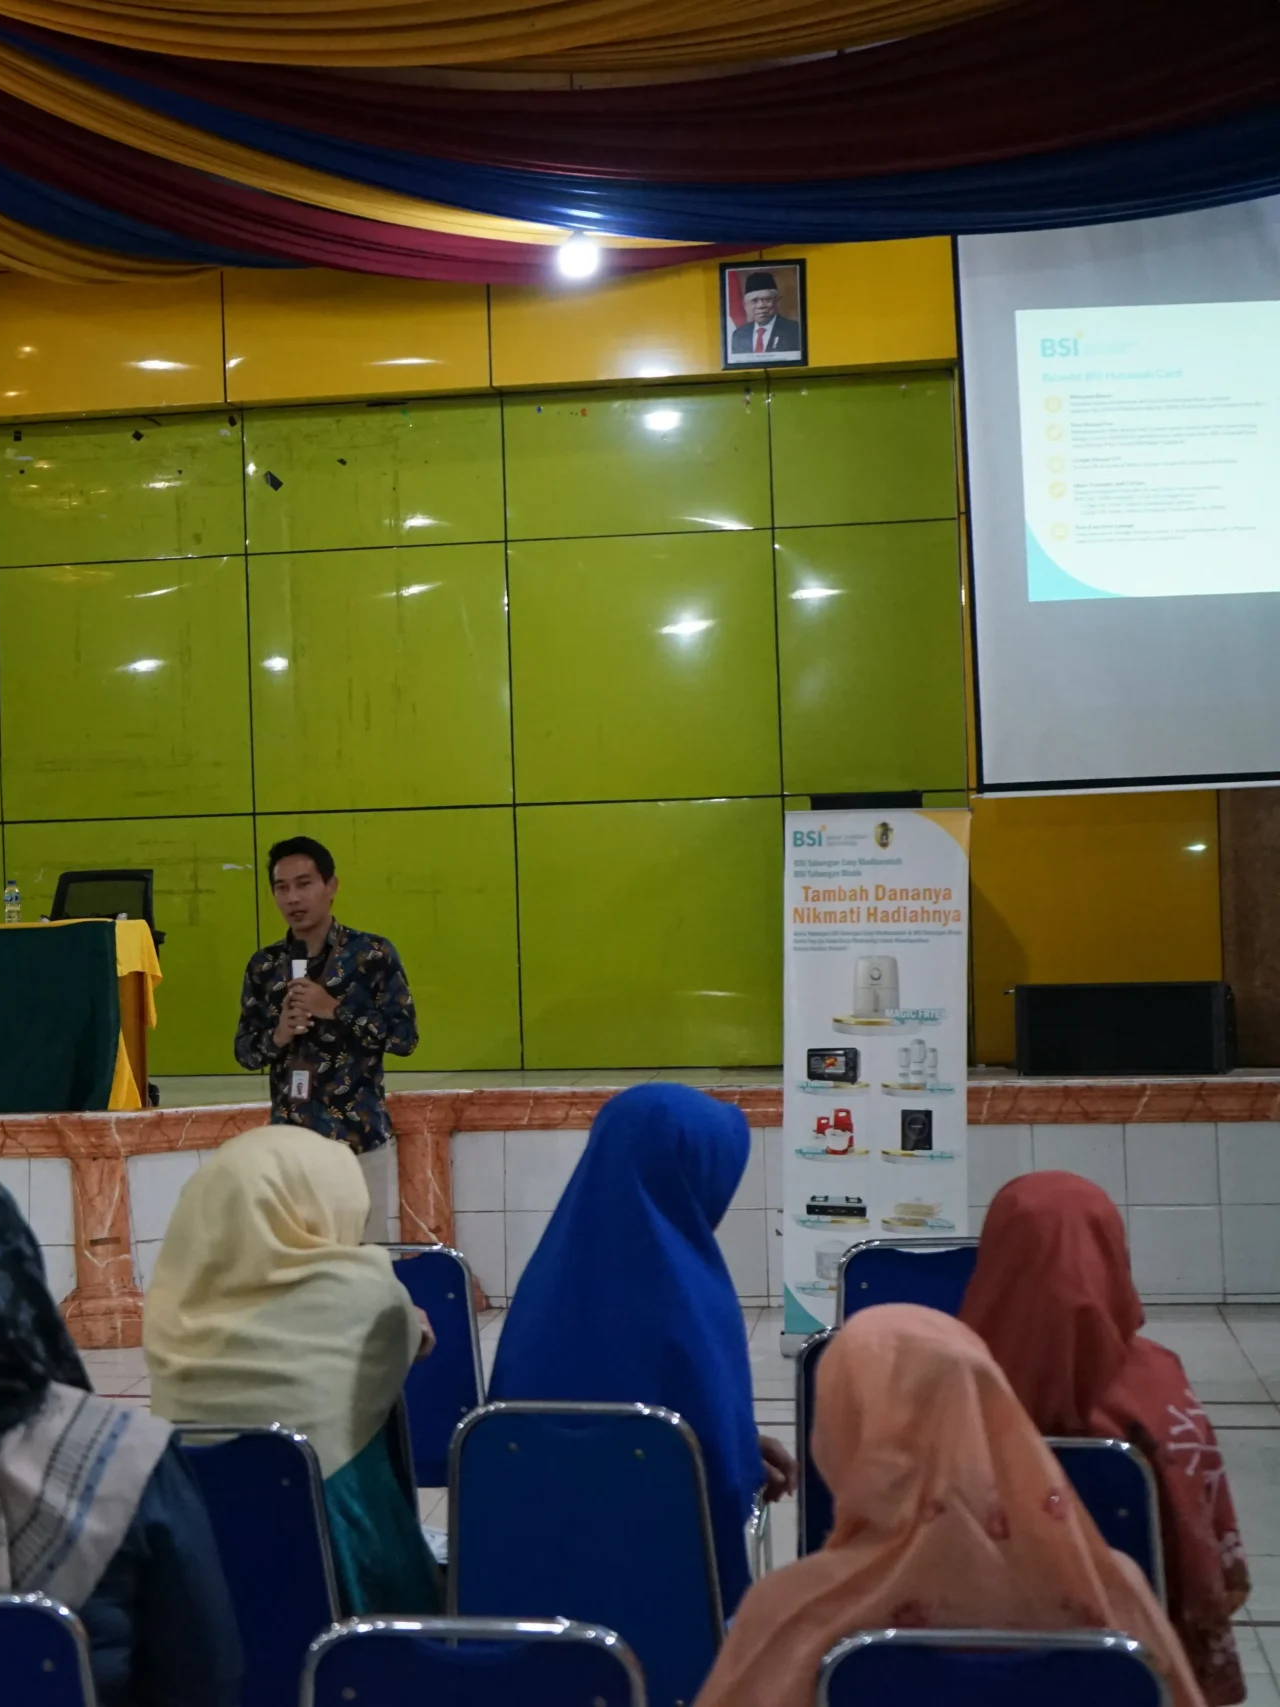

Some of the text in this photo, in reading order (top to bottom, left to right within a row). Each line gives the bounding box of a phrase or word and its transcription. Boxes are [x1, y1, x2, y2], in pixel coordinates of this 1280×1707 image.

[1040, 337, 1079, 358] BSI
[793, 830, 823, 848] BSI
[802, 884, 952, 904] Tambah Dananya
[792, 905, 962, 927] Nikmati Hadiahnya
